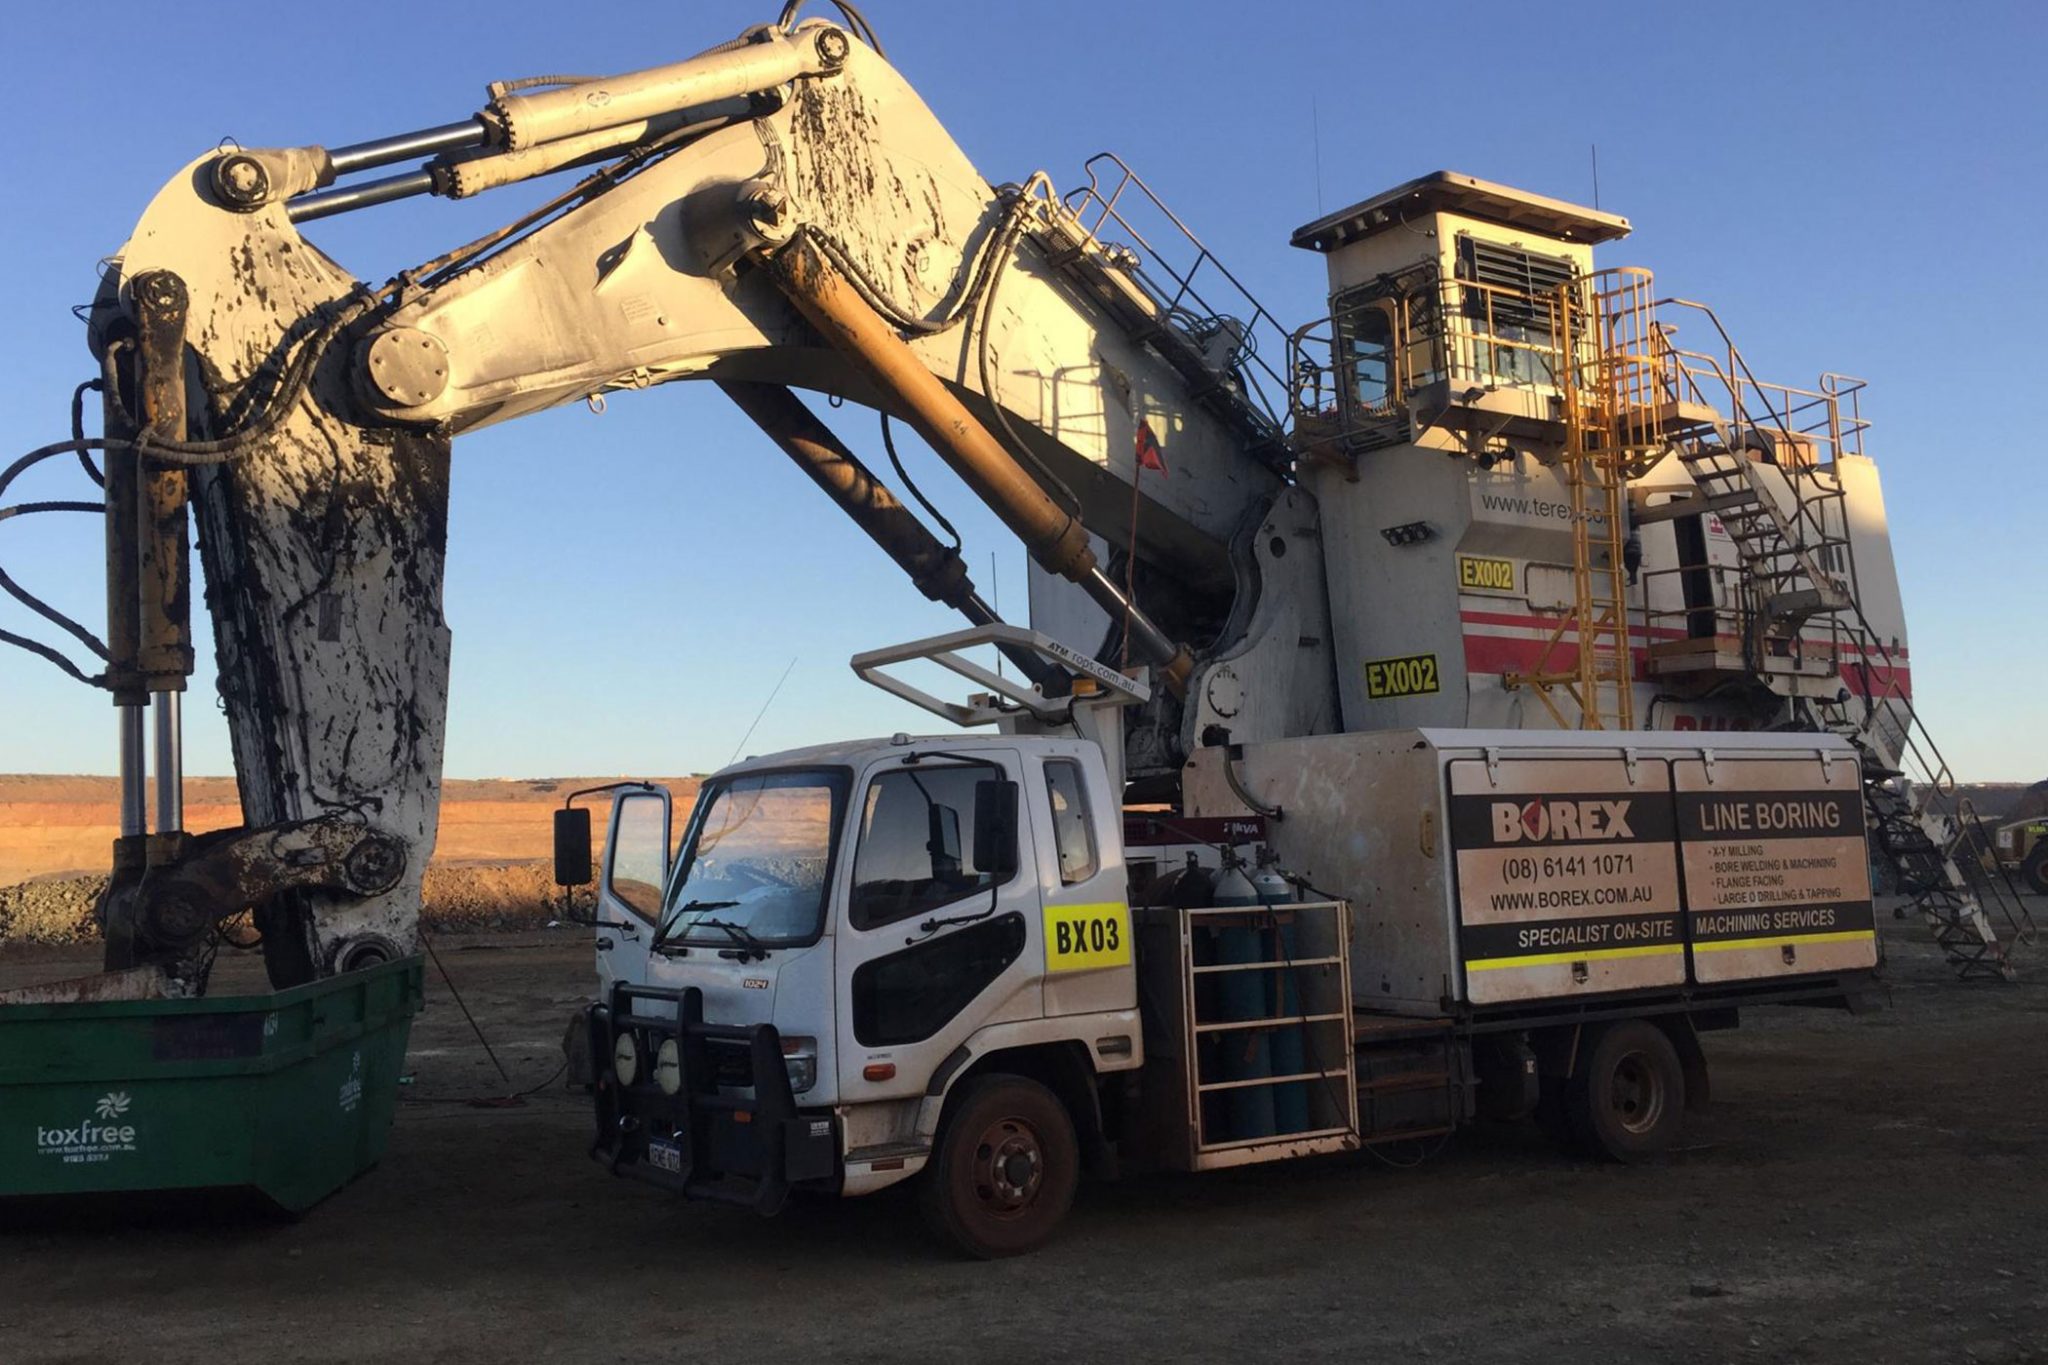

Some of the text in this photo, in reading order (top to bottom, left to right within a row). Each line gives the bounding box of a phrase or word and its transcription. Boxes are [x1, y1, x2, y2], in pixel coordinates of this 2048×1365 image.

[1462, 559, 1511, 588] EX002
[1047, 642, 1069, 657] ATM
[1368, 658, 1437, 695] EX002
[1491, 798, 1635, 842] BOREX
[1700, 801, 1840, 831] LINE BORING
[1728, 845, 1763, 857] MILLING
[1502, 854, 1633, 884] (08) 6141 1071
[1715, 861, 1739, 873] BORE
[1741, 860, 1780, 872] WELDING
[1789, 858, 1837, 870] MACHINING
[1716, 875, 1784, 889] FLANGE FACING
[1718, 891, 1746, 904] LARGE
[1758, 890, 1797, 902] DRILLING
[1806, 887, 1842, 899] TAPPING
[1491, 886, 1653, 911] WWW.BOREX.COM.AU
[1056, 918, 1119, 954] BX03
[1518, 909, 1836, 948] SPECIALIST ON-SITE MACHINING SERVICES
[37, 1119, 136, 1146] toxfree
